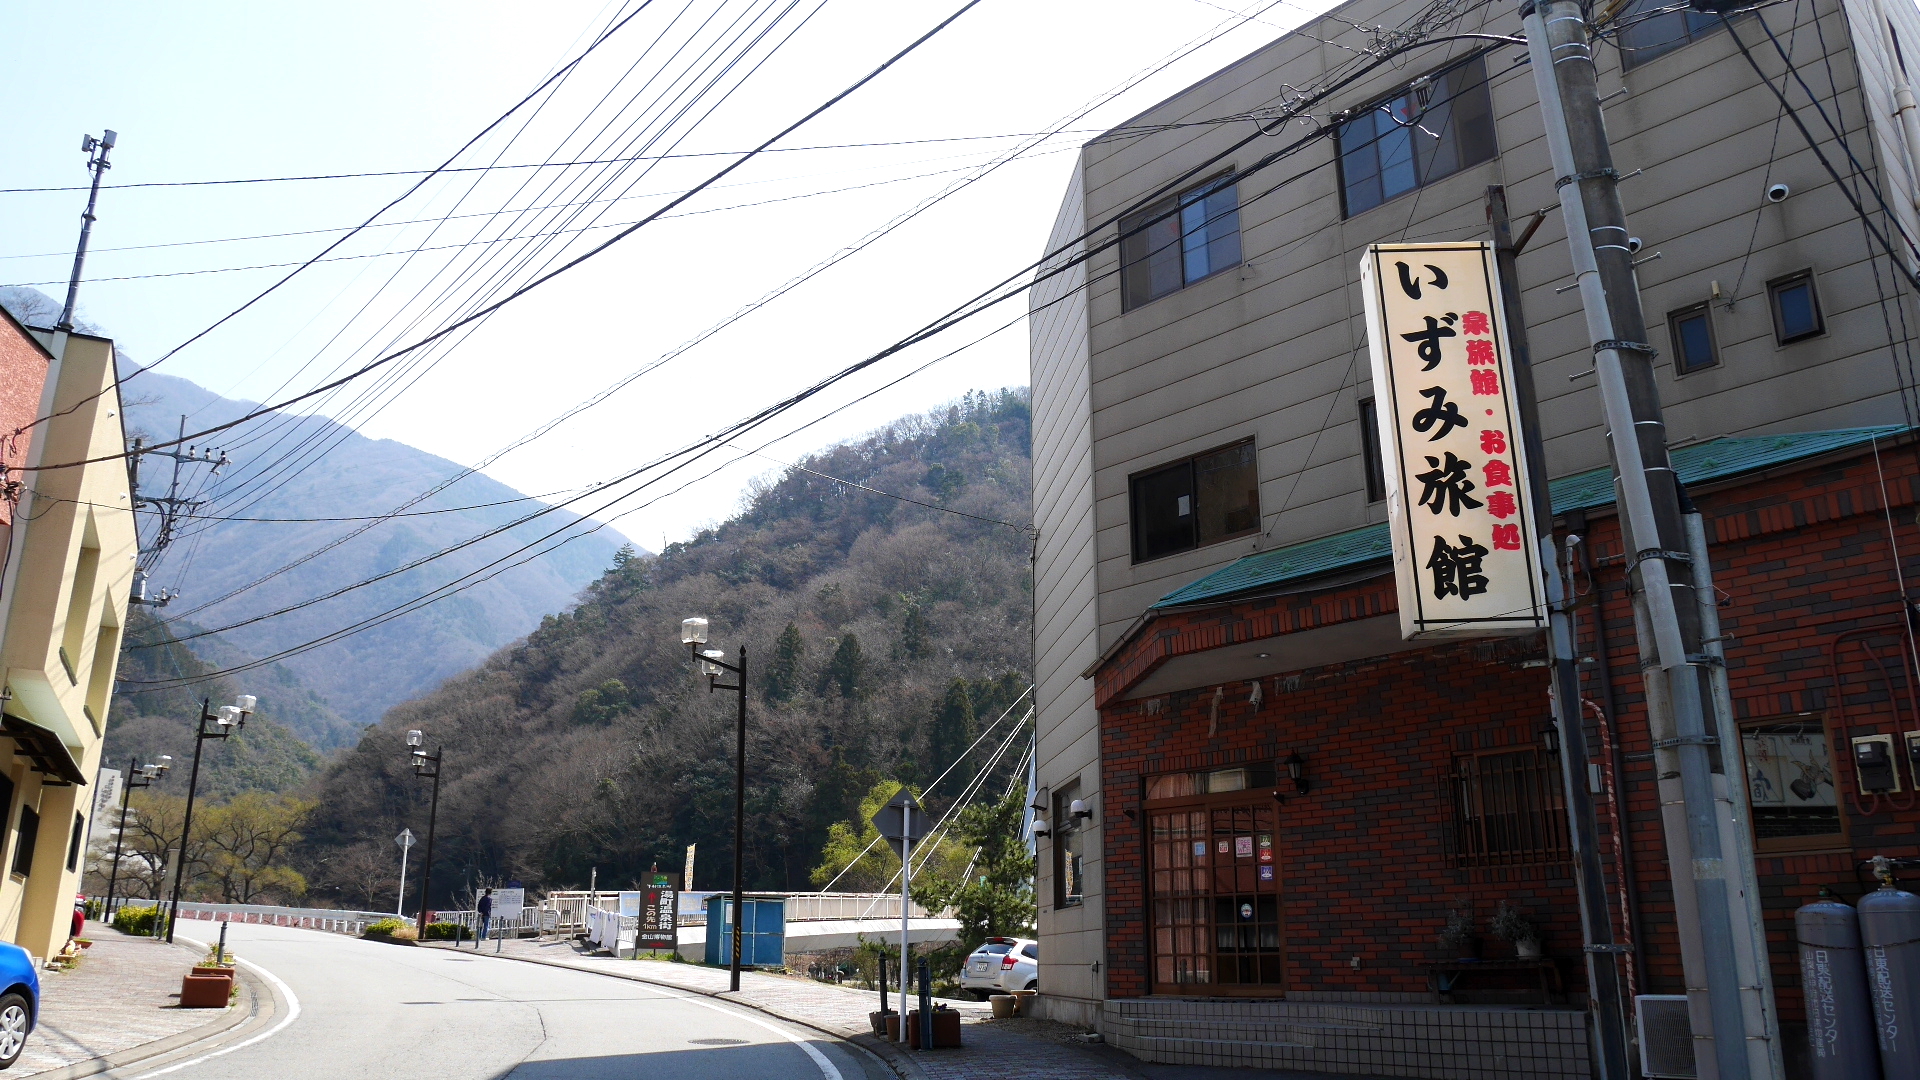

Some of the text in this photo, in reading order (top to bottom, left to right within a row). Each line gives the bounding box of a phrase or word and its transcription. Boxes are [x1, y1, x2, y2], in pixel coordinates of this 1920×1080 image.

[1395, 260, 1490, 602] いずみ旅館
[646, 904, 656, 923] この先
[658, 890, 674, 930] 湯町温泉街
[1815, 950, 1838, 1056] 日東配送センター
[1873, 944, 1898, 1053] 日東配送センター
